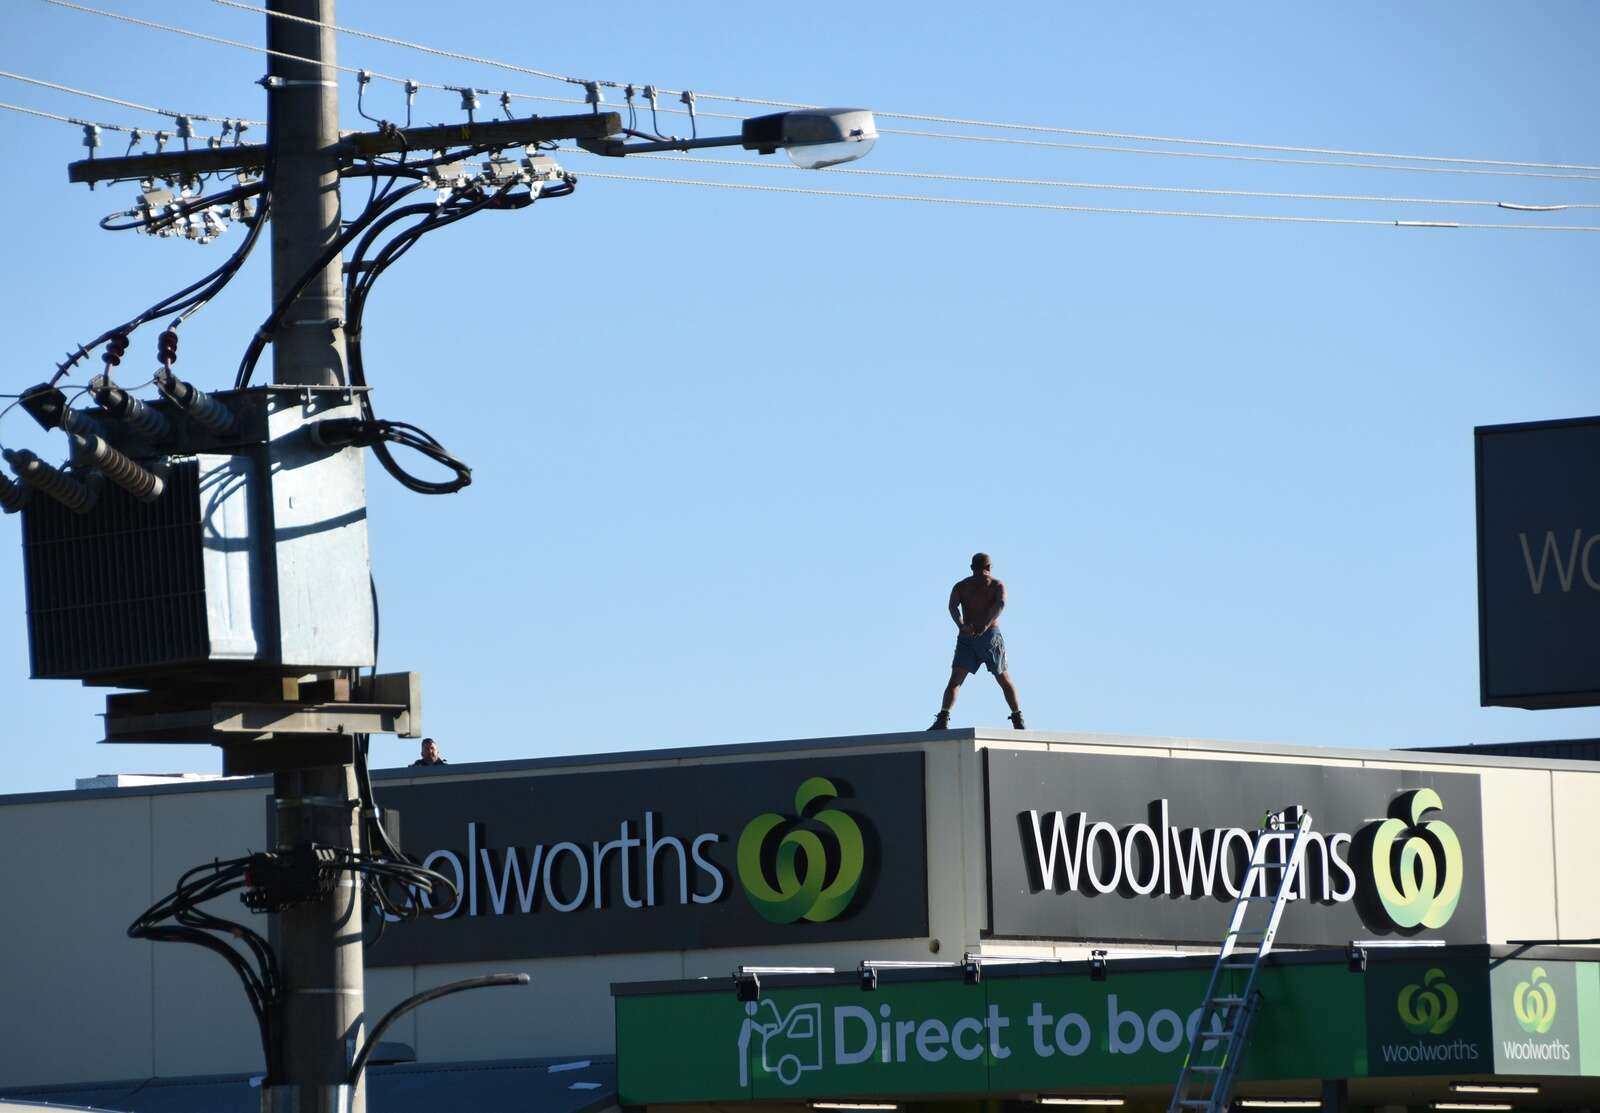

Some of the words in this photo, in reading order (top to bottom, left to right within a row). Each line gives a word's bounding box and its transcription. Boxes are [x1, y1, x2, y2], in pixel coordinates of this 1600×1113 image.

[375, 811, 725, 921] olworths
[1029, 798, 1357, 902] Woolworths
[834, 1003, 1011, 1065] Direct
[1027, 1003, 1091, 1057] to
[1107, 994, 1240, 1054] boo
[1381, 1040, 1480, 1062] Woolworths
[1503, 1038, 1571, 1061] Woolworths
